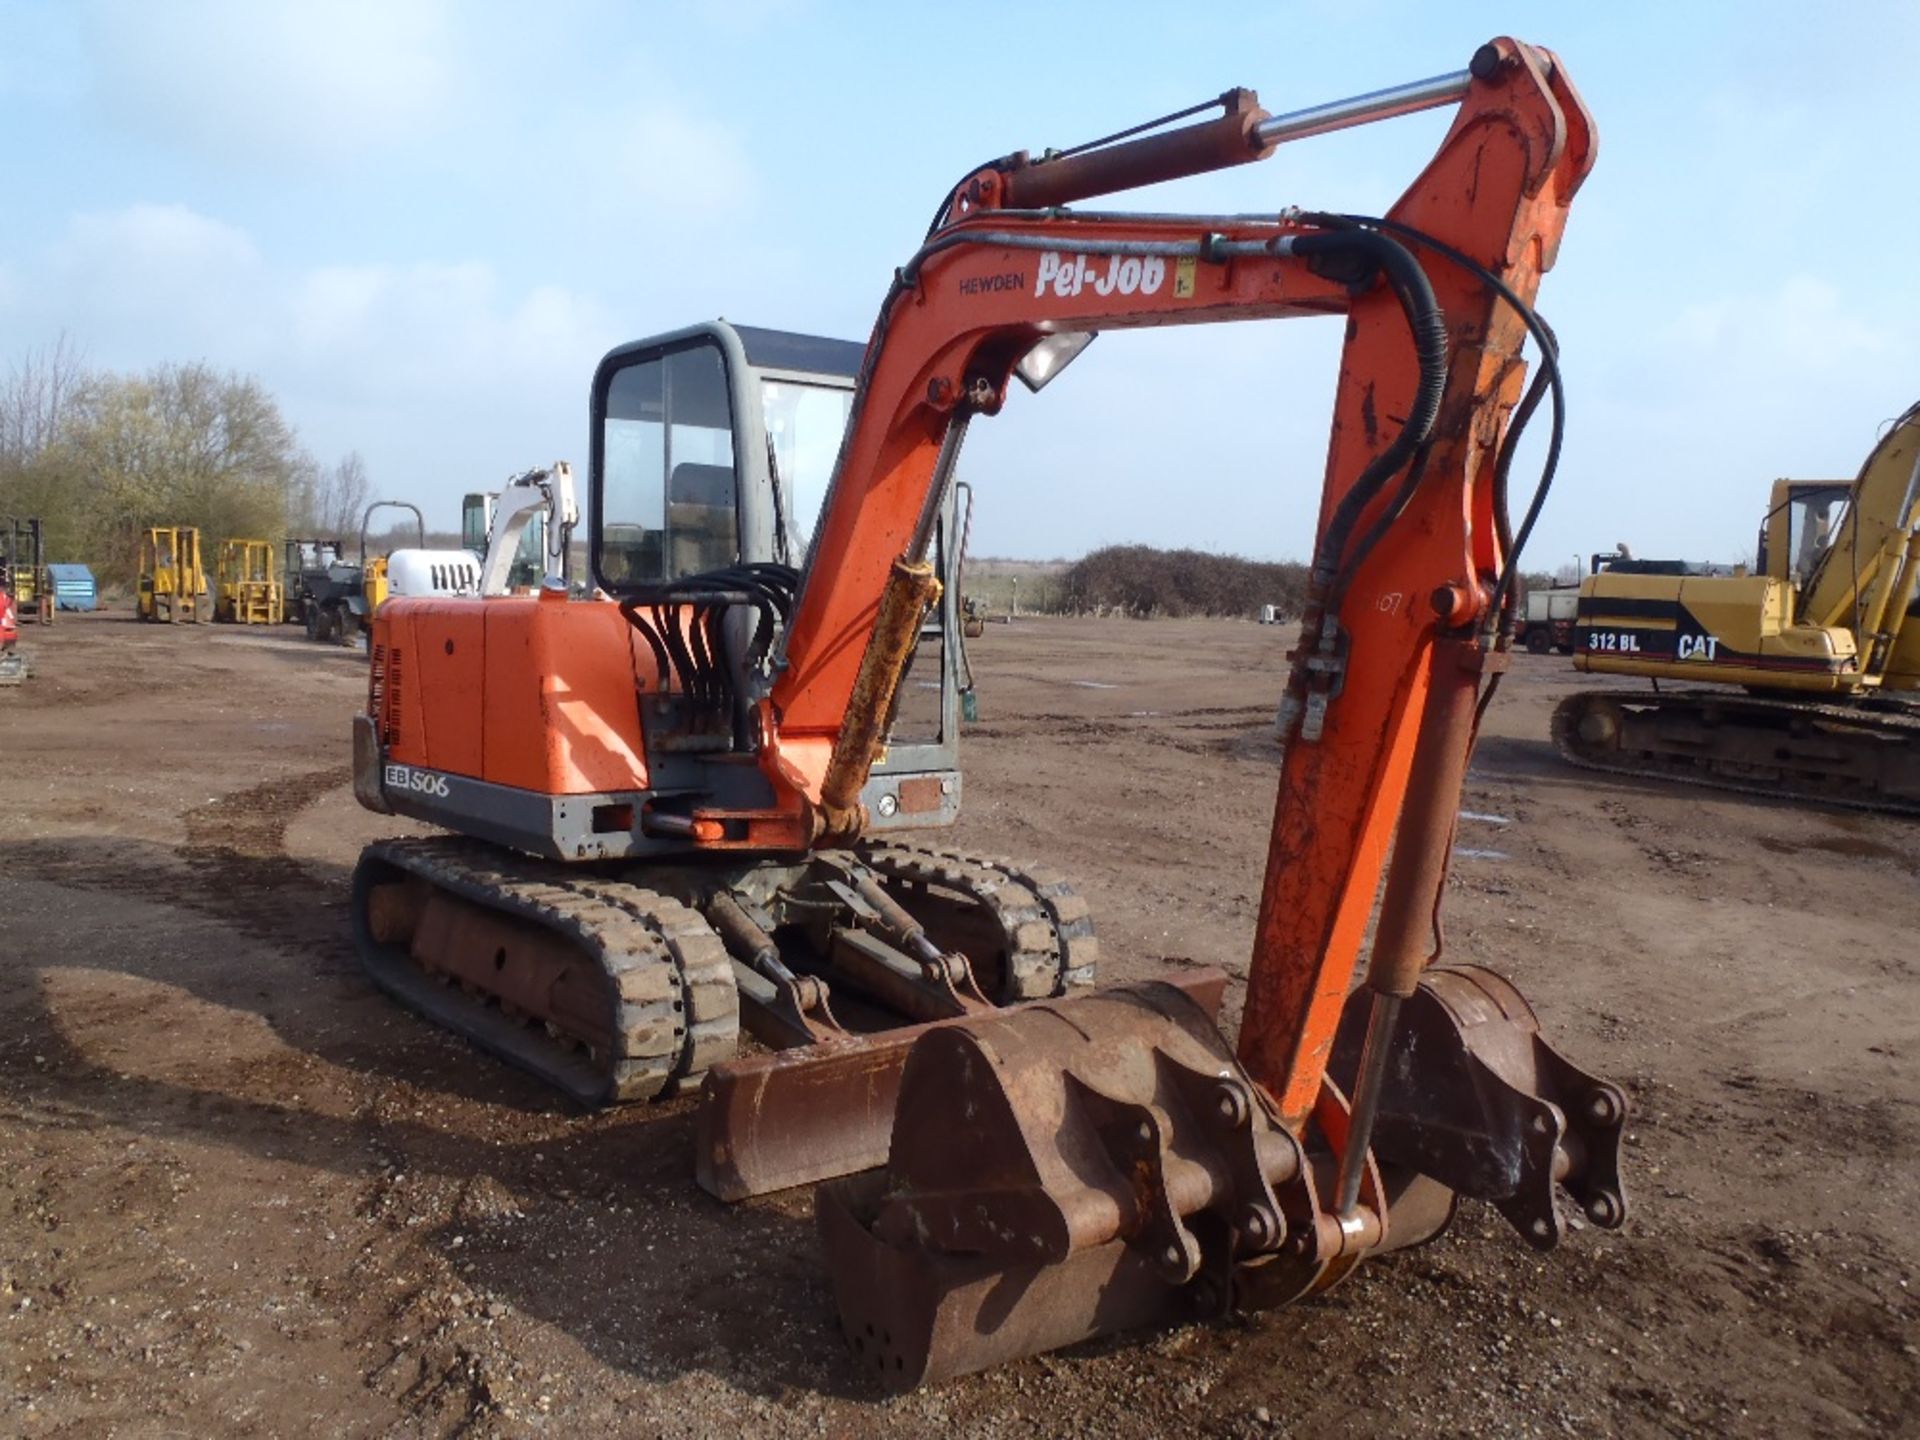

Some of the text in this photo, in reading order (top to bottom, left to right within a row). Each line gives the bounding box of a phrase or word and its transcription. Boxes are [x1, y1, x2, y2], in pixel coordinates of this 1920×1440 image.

[959, 273, 1025, 296] HEWDEN
[1035, 251, 1165, 298] Pel-Job
[1589, 633, 1640, 652] 312 BL
[1678, 634, 1719, 661] CAT
